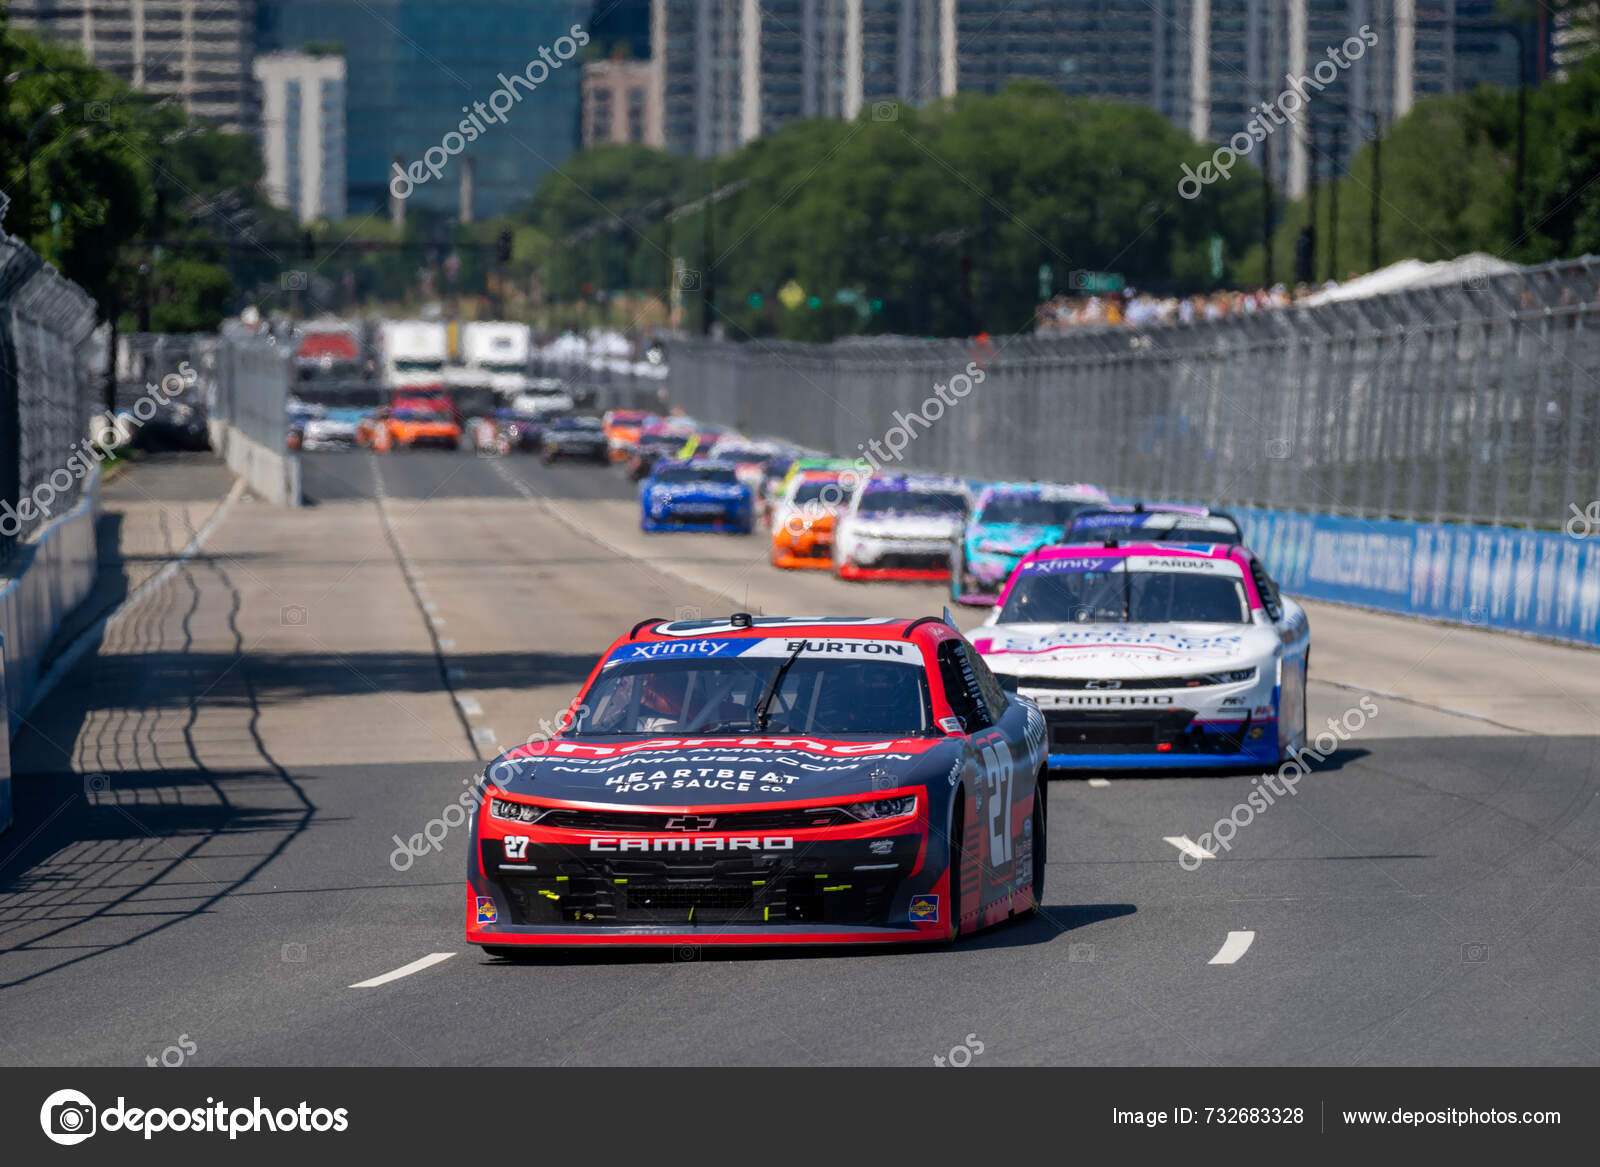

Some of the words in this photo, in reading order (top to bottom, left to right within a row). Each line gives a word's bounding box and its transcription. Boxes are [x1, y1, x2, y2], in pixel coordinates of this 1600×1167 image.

[1036, 558, 1104, 572] xfinity
[1148, 560, 1215, 569] PARDUS
[631, 639, 730, 659] xfinity
[786, 640, 904, 656] BURTON
[1034, 695, 1174, 706] CAMARO
[553, 738, 894, 755] norma
[686, 747, 912, 763] AMMUNITION
[552, 756, 861, 774] NORMAUSA.COM
[604, 768, 800, 786] HEARTBEAT
[615, 781, 665, 793] HOT
[671, 779, 751, 792] SAUCE
[981, 740, 1014, 868] 27
[503, 835, 530, 859] 27
[589, 836, 794, 852] CAMARO
